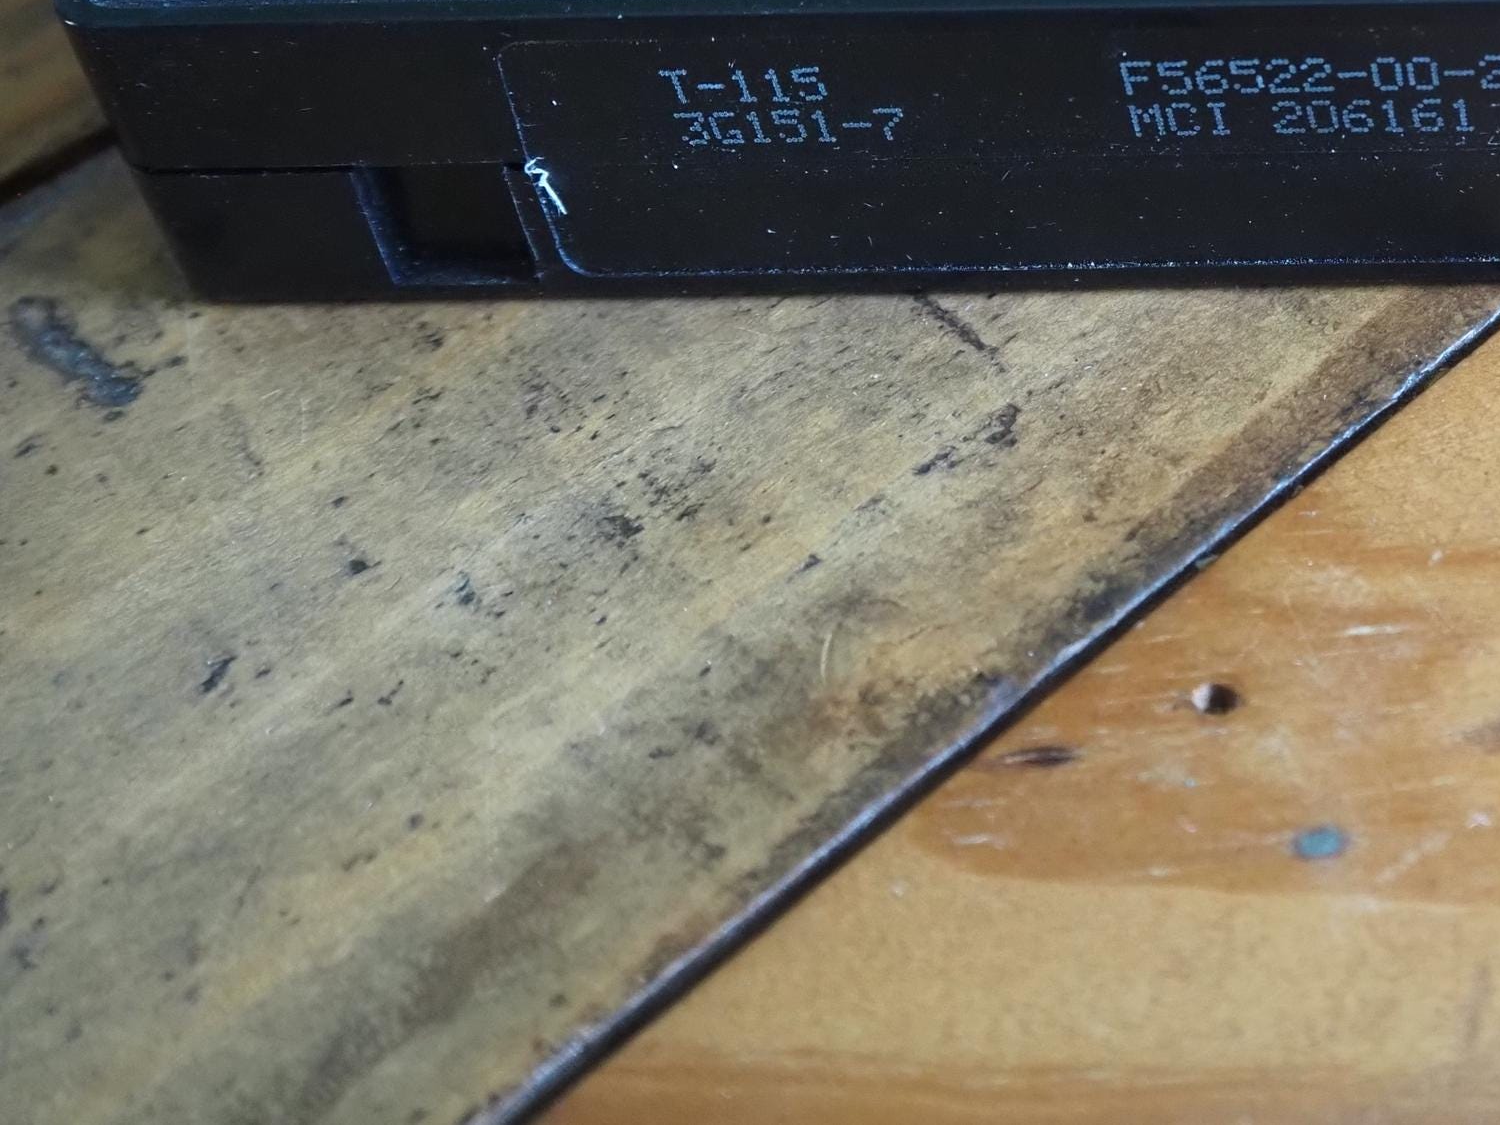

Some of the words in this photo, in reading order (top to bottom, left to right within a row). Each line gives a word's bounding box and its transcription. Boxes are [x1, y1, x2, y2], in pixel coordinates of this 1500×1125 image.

[659, 66, 826, 103] T-115
[673, 106, 904, 146] 3G151-7
[1129, 101, 1230, 137] MCI
[1272, 97, 1478, 133] 206161
